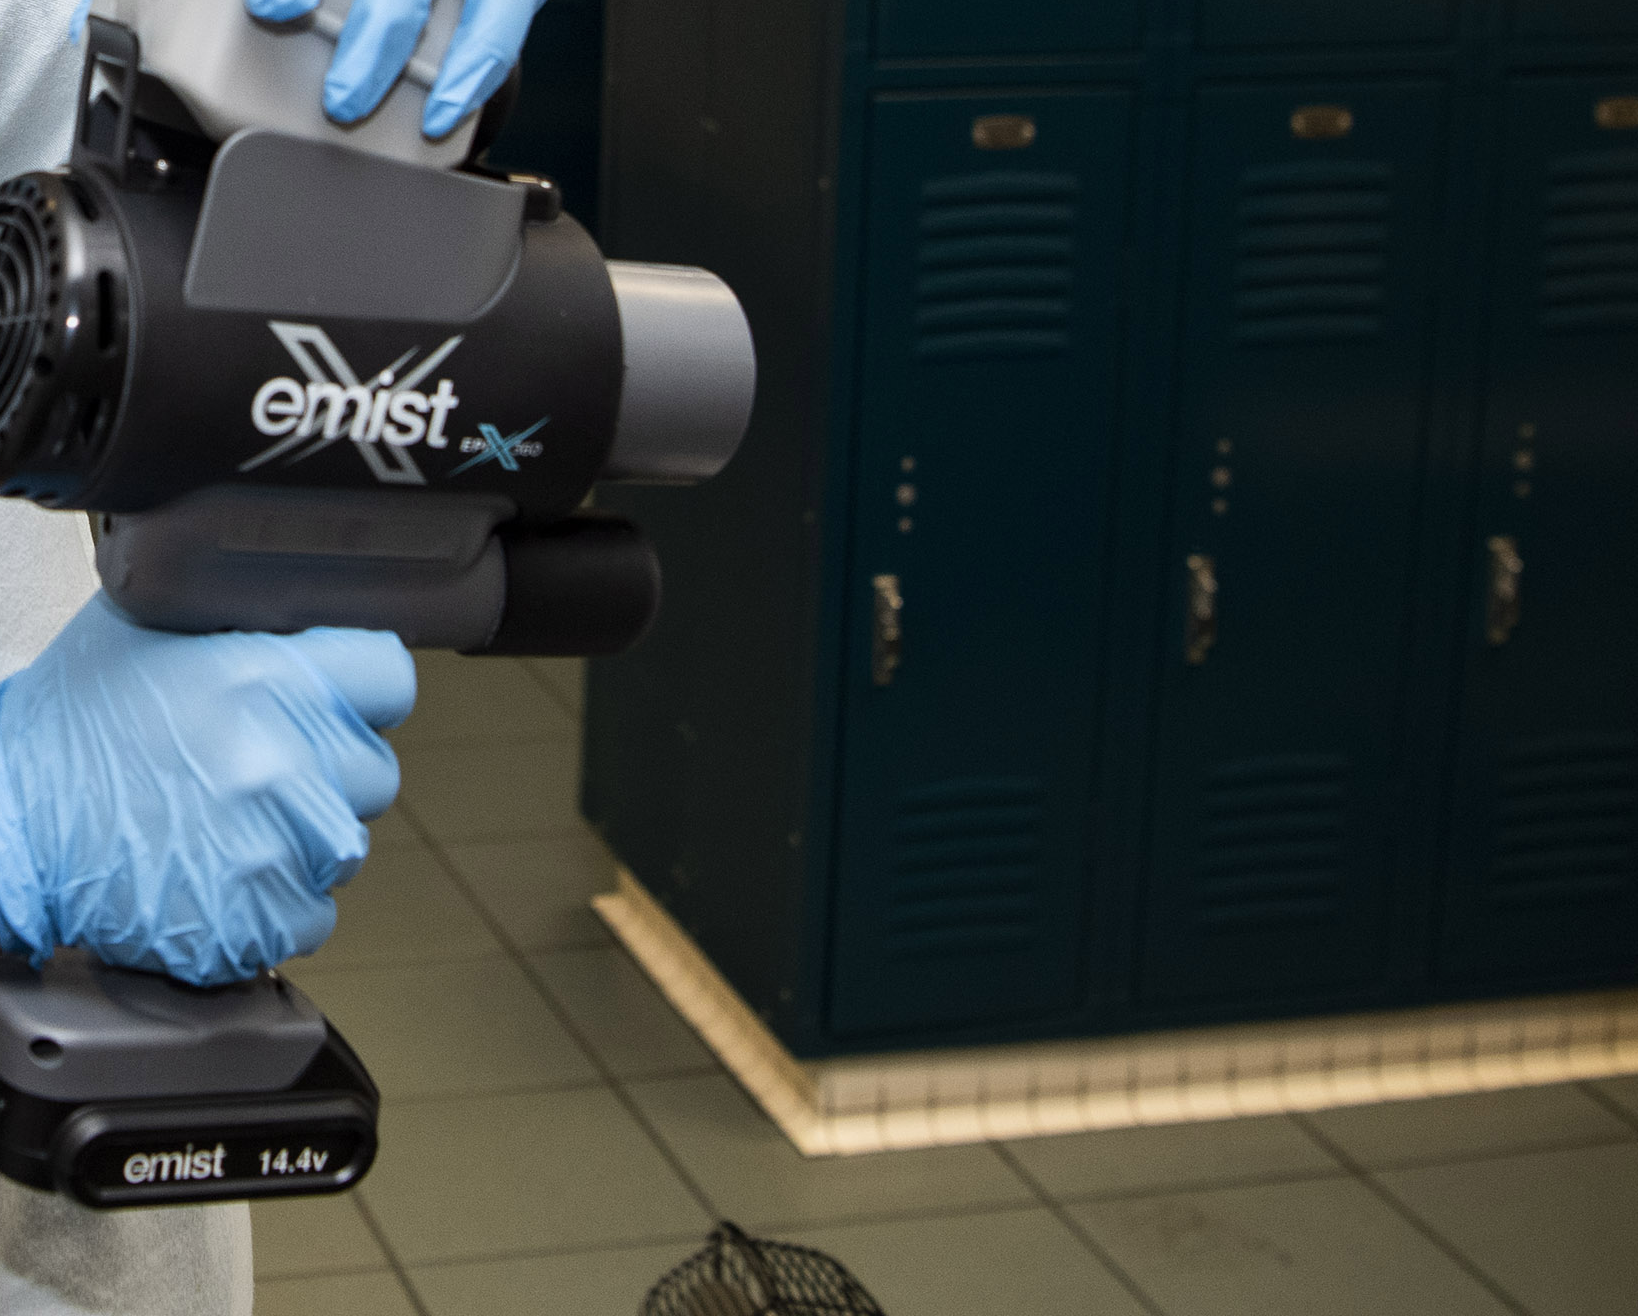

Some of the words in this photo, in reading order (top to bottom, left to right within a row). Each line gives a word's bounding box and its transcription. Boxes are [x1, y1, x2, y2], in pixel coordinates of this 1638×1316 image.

[250, 369, 460, 450] emist
[122, 1141, 228, 1185] emist
[258, 1145, 330, 1176] 14.4v
